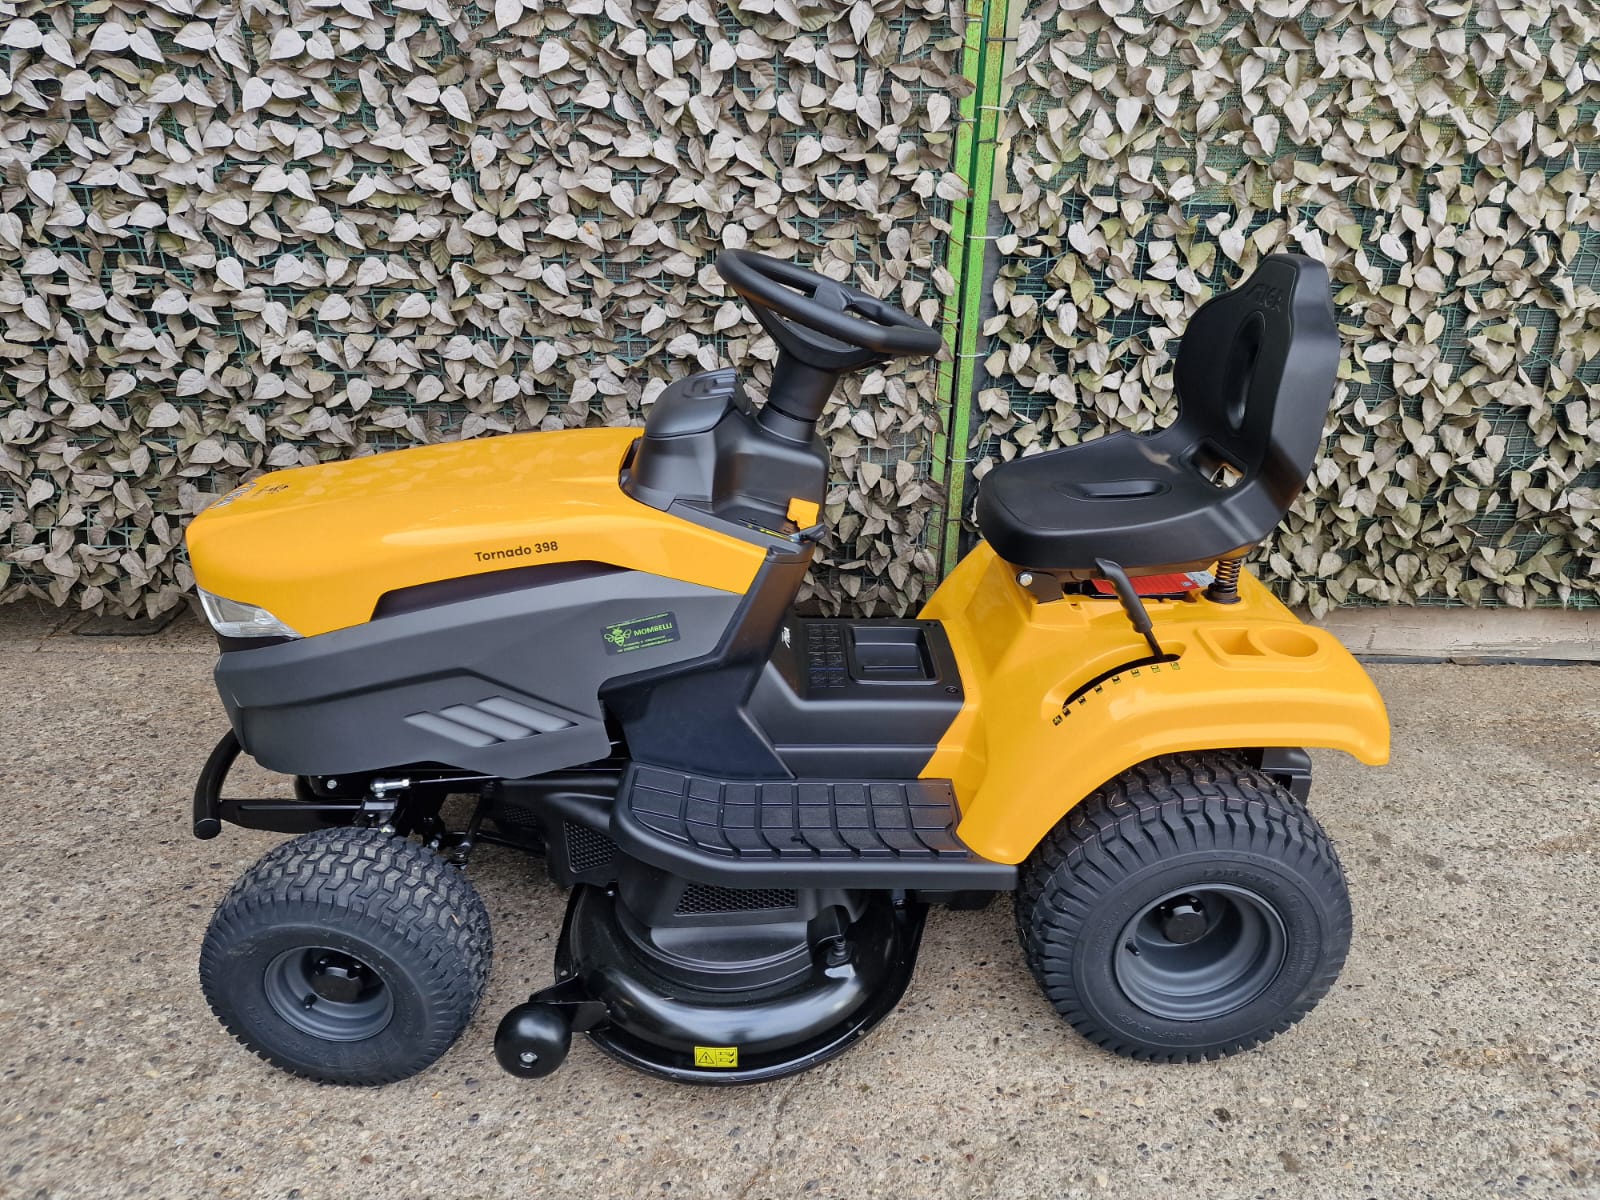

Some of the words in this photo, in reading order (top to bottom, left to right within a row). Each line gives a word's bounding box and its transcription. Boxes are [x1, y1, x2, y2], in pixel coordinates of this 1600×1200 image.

[474, 546, 532, 562] Tornado
[534, 541, 559, 554] 398
[633, 622, 673, 637] MOMBELLI
